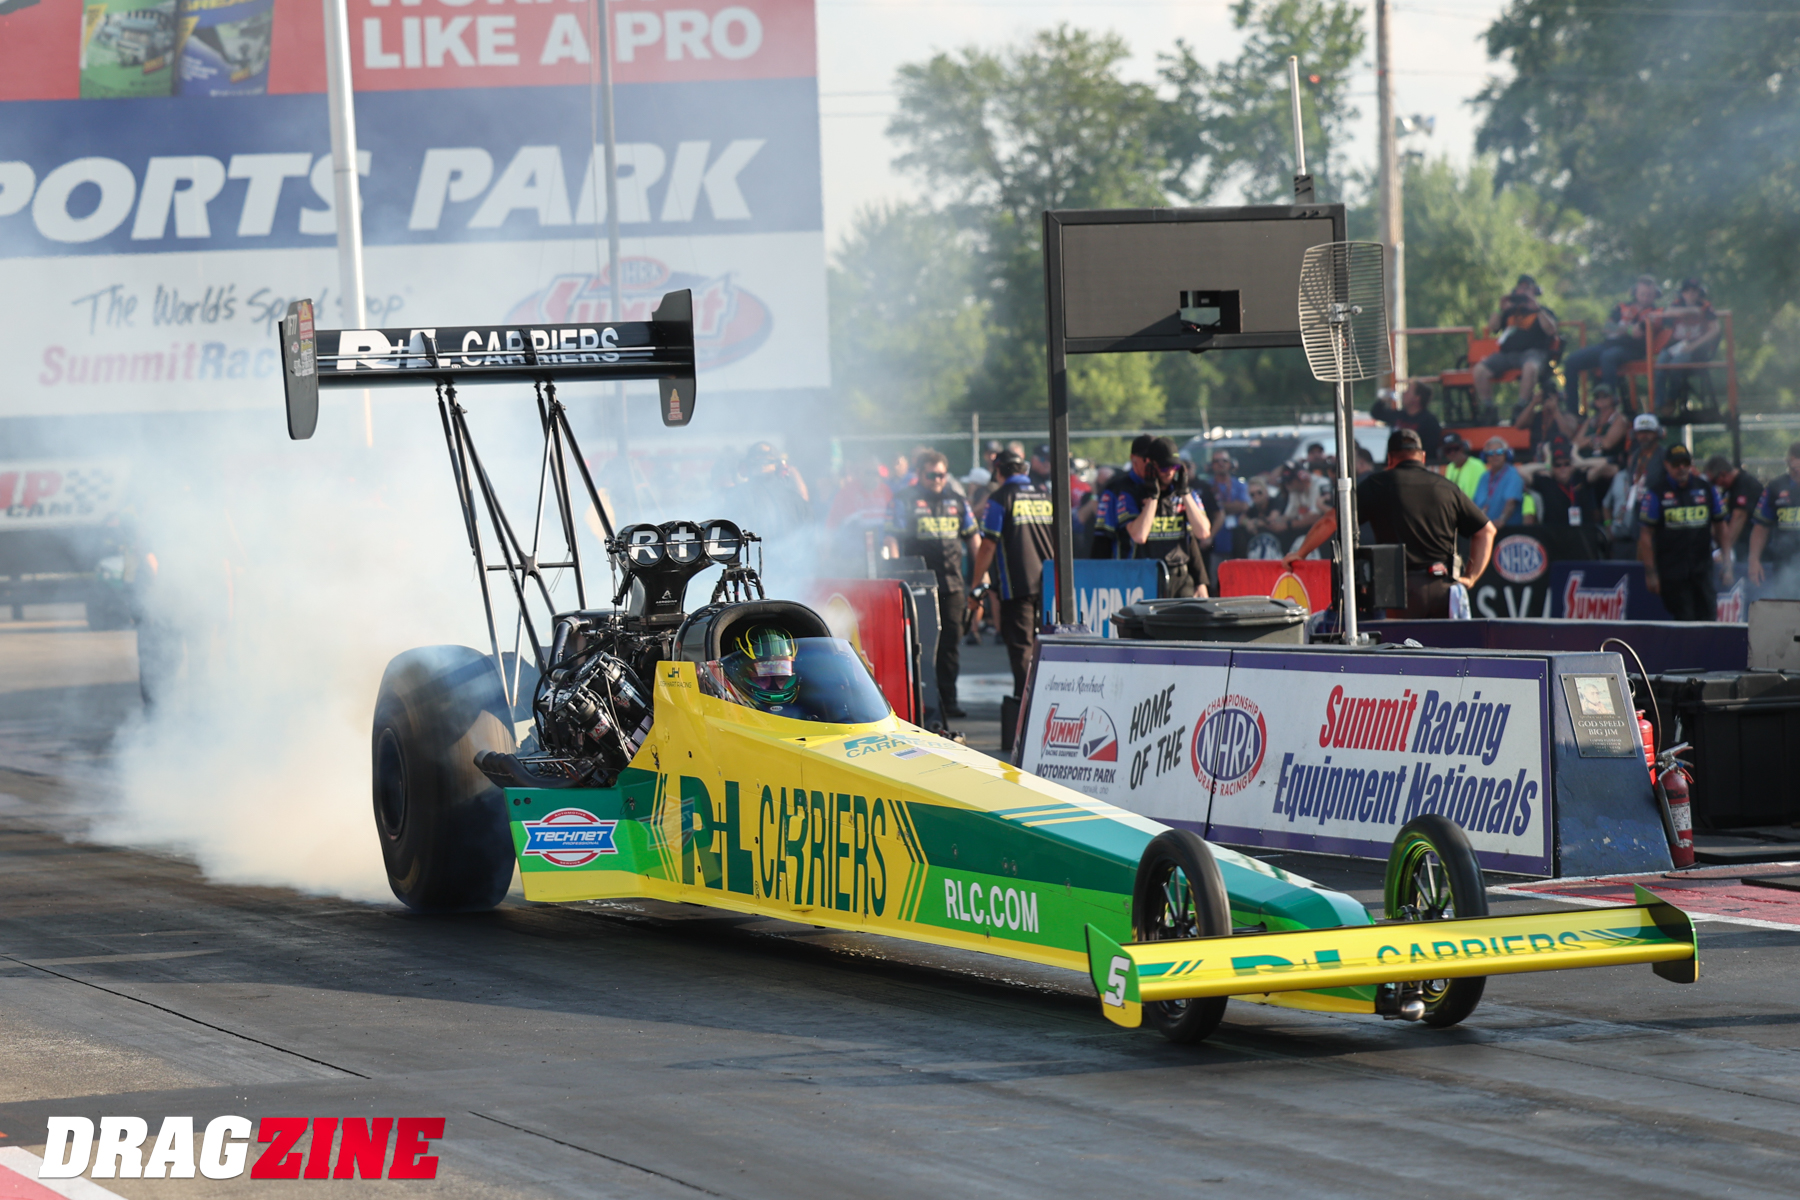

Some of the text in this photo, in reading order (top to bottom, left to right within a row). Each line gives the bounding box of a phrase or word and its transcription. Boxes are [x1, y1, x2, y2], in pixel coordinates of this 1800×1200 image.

[363, 7, 763, 68] LIKE A PRO
[408, 139, 767, 230] PARK
[72, 284, 139, 335] The
[153, 283, 237, 326] World's
[246, 286, 328, 338] Spd
[462, 327, 620, 366] CARRIERS
[1664, 505, 1708, 522] REED
[1500, 544, 1541, 571] NHRA
[1129, 683, 1175, 744] HOME
[1207, 694, 1259, 716] CHAMPIONSHIP
[1319, 684, 1511, 766] Summit Racing
[1130, 725, 1185, 790] OF THE
[1201, 712, 1255, 777] NHRA
[1036, 763, 1116, 783] MOTORSPORTS PARK
[1197, 770, 1249, 796] DRAG RACING
[1272, 752, 1538, 836] Equipment Nationals
[759, 784, 887, 917] CARRIERS
[944, 878, 1039, 933] RLC.COM
[1104, 954, 1131, 1007] 5
